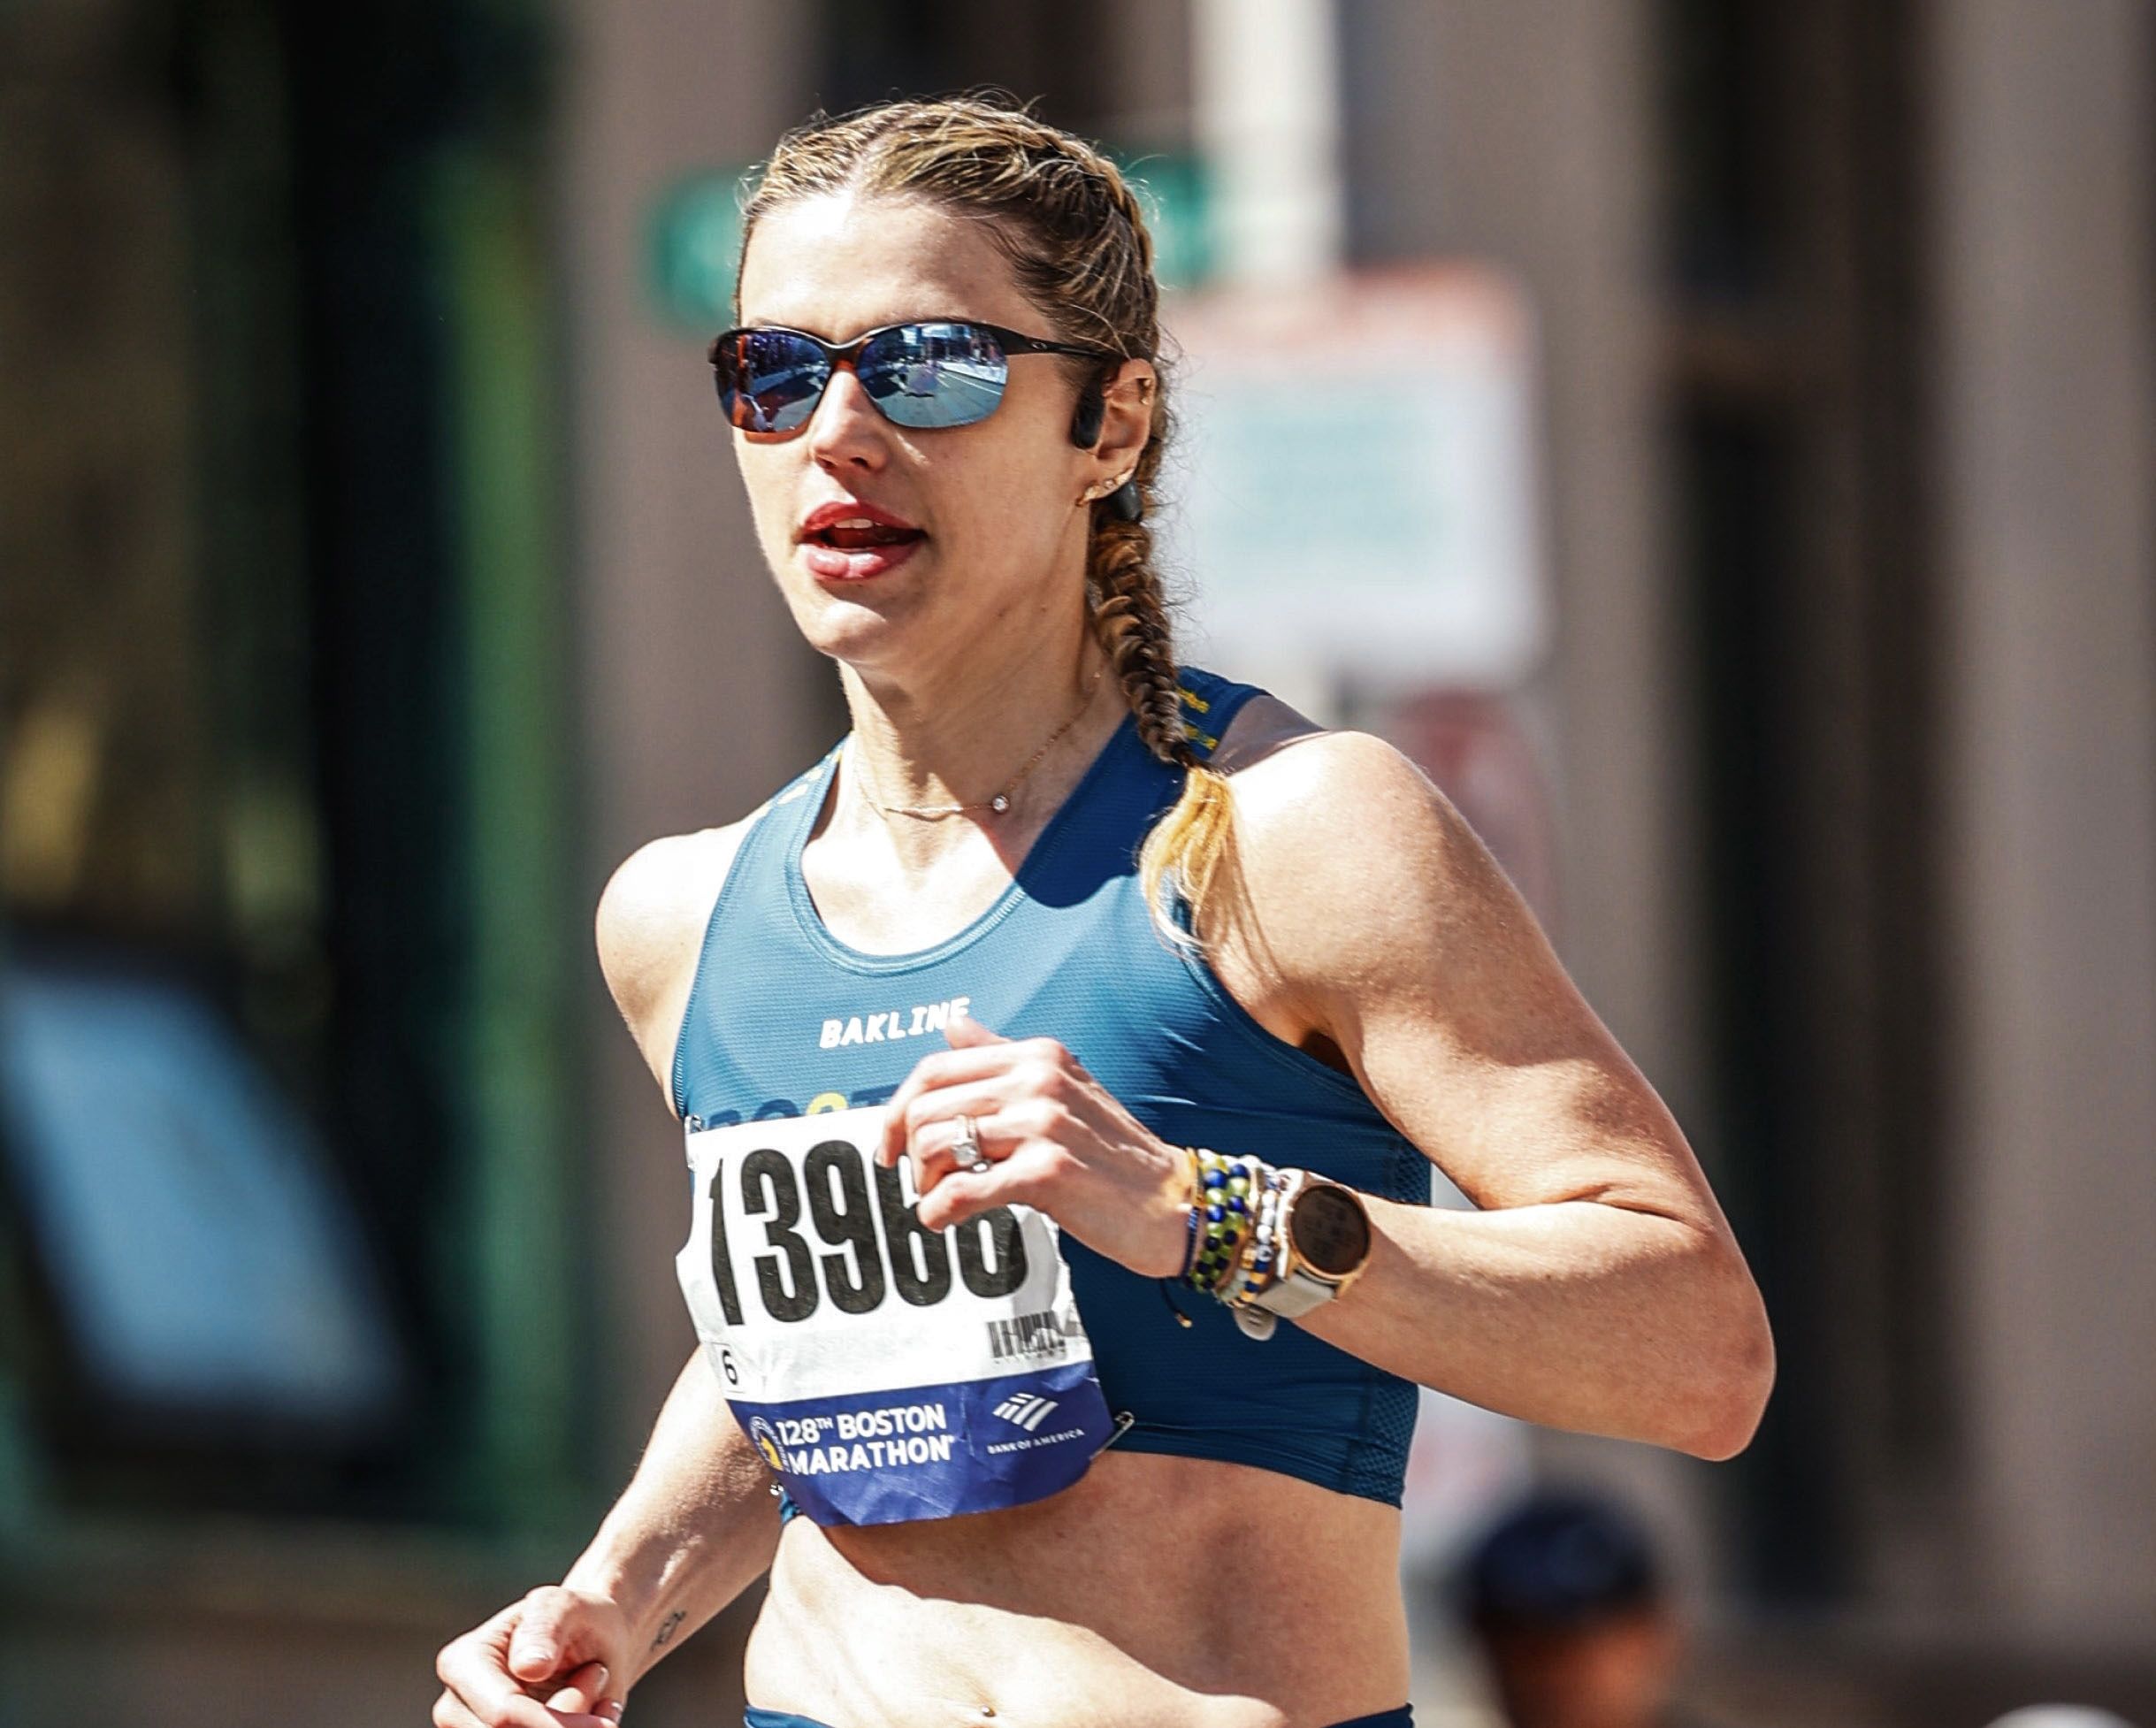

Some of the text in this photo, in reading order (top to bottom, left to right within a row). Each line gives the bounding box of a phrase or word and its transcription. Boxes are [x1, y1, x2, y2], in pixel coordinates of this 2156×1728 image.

[819, 996, 970, 1049] BAKLINE
[722, 1349, 738, 1386] 6
[776, 1417, 834, 1447] 128TH
[837, 1403, 947, 1441] BOSTON
[987, 1427, 1086, 1455] BANK OF AMERICA
[787, 1434, 952, 1476] MARATHON
